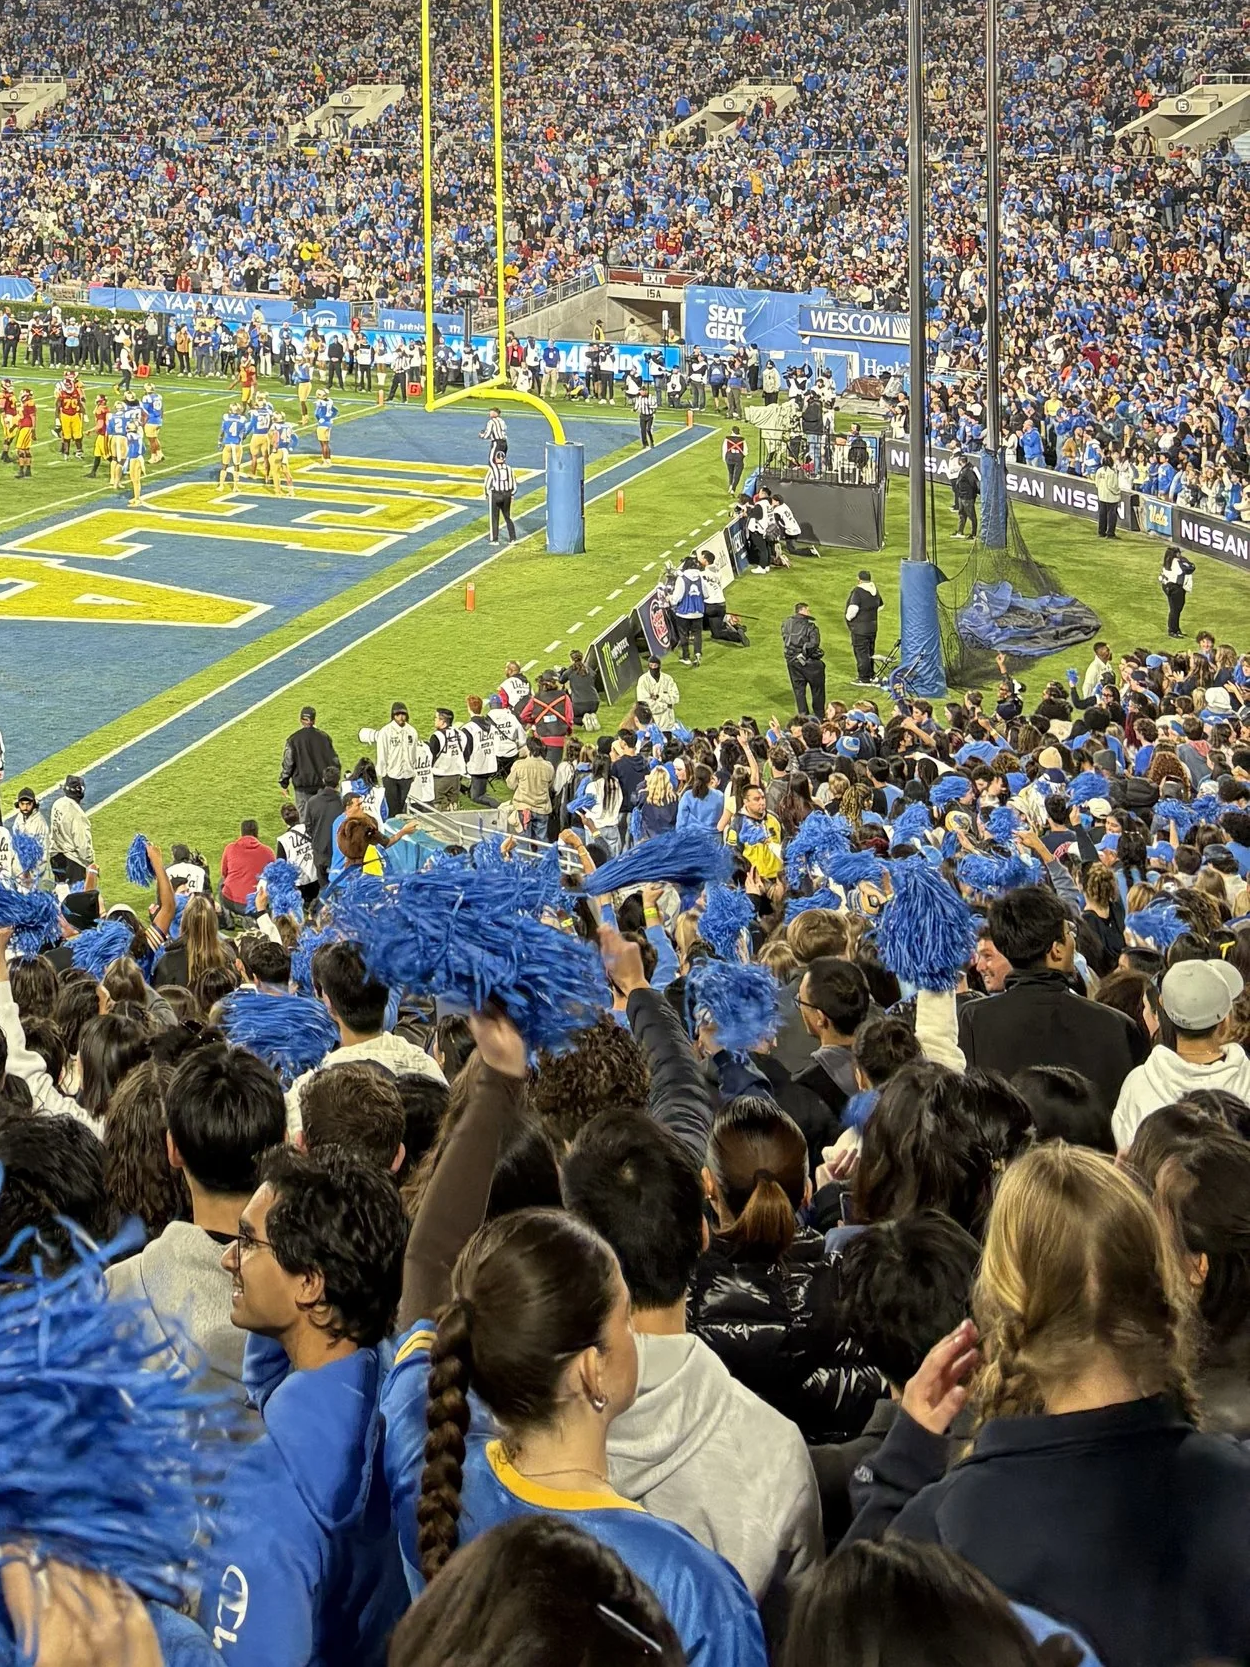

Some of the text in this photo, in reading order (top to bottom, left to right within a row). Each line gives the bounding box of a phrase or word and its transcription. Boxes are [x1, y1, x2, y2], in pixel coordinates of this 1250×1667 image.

[642, 273, 667, 284] EXIT
[646, 289, 661, 299] 15A
[709, 304, 746, 324] SEAT
[810, 310, 890, 335] WESCOM
[351, 317, 360, 331] 2
[706, 322, 746, 344] GEEK
[410, 384, 418, 394] G
[114, 418, 123, 434] 2
[230, 422, 237, 437] 4
[1053, 484, 1125, 520] NISSN
[1149, 504, 1169, 527] Ucla
[1181, 519, 1249, 560] NISSAN
